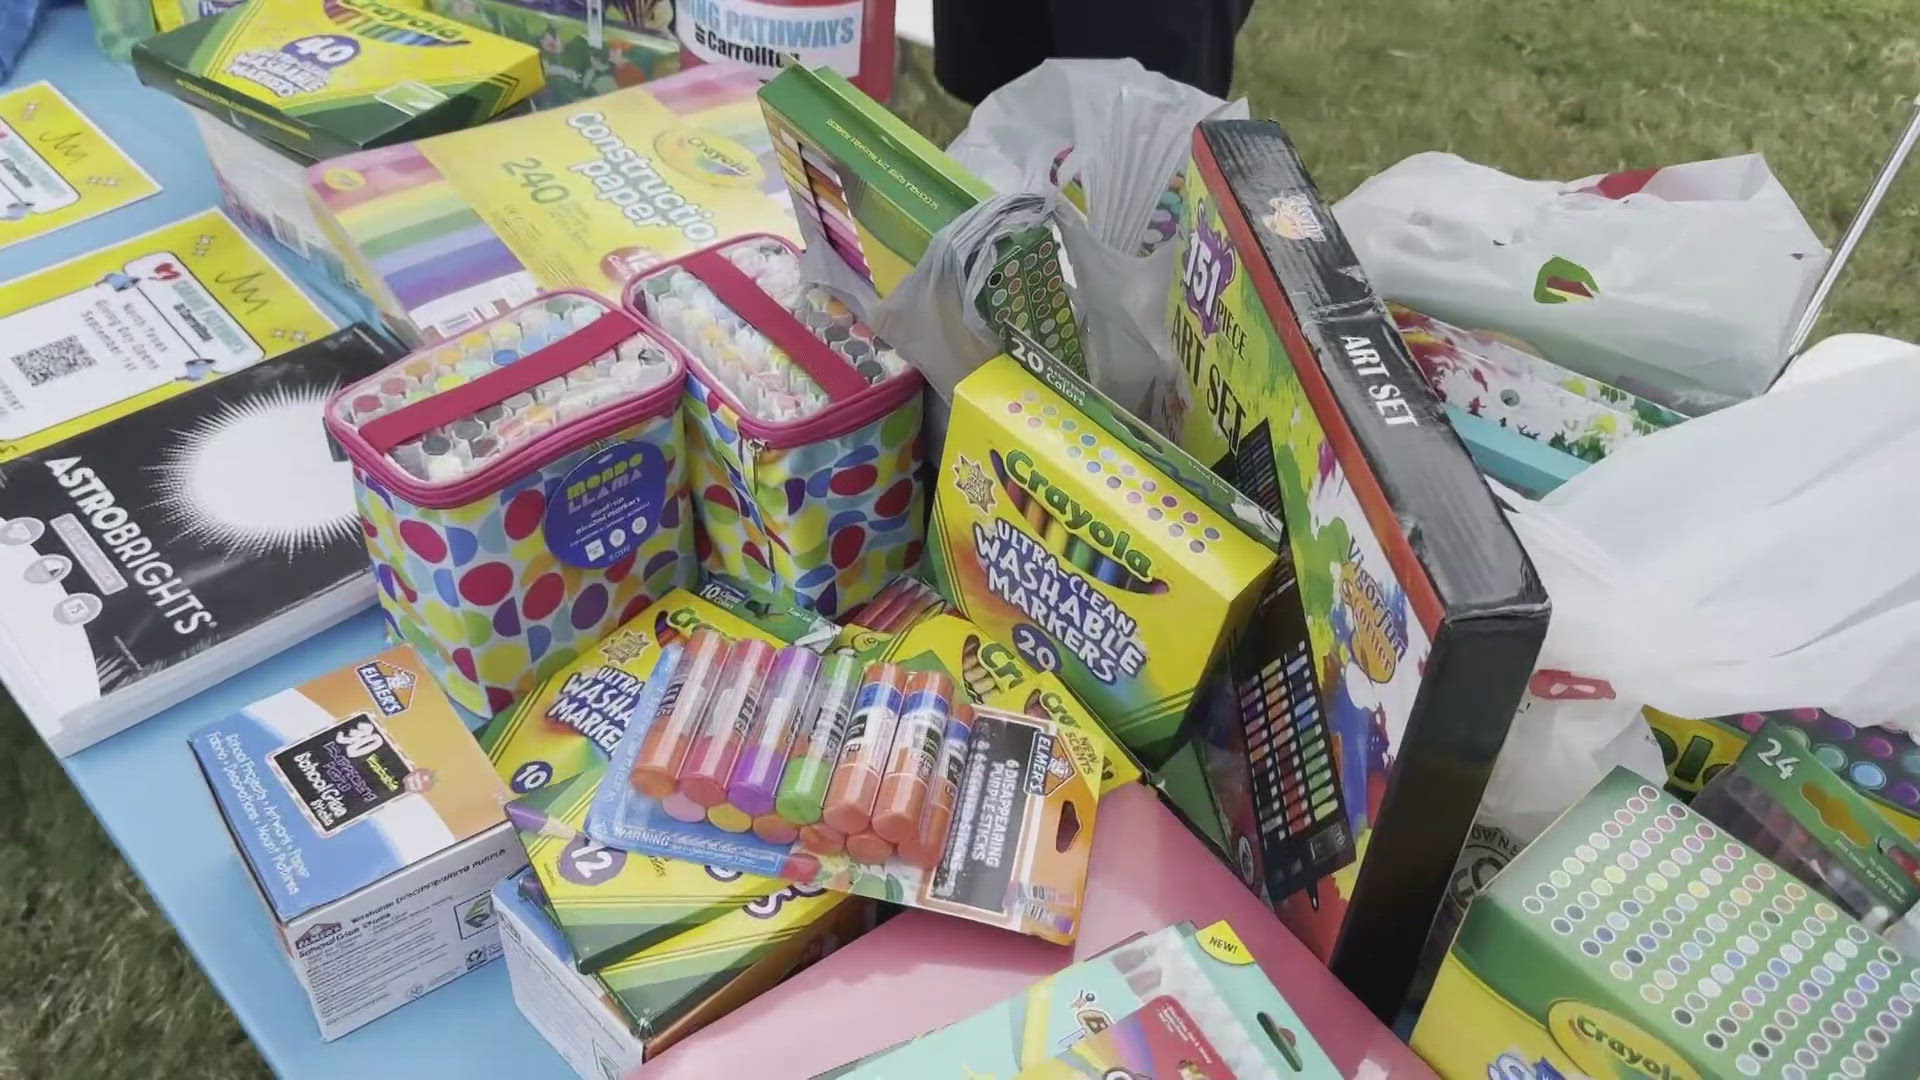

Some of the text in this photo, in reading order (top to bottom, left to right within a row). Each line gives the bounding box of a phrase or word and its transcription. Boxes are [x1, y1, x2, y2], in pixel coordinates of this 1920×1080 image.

[296, 37, 355, 63] 40
[708, 30, 799, 68] Carrollto
[726, 10, 854, 48] PATHWAYS
[502, 157, 570, 203] 240
[567, 112, 716, 241] Constructio
[568, 159, 670, 227] paper
[1184, 231, 1222, 318] 151
[1214, 298, 1248, 361] PIECE
[1011, 337, 1044, 374] 20
[1045, 373, 1085, 407] Colors
[1171, 304, 1247, 457] ART SET
[1340, 336, 1421, 428] ART SET
[1005, 450, 1153, 578] Crayola
[45, 456, 210, 634] ASTROBRIGHTS
[700, 583, 719, 599] 10
[975, 523, 1146, 676] WASHABLE
[996, 519, 1135, 635] ULTRA-CLEAN
[989, 564, 1117, 684] MARKERS
[1017, 631, 1056, 671] 20
[360, 666, 402, 714] ELMER'S
[561, 672, 637, 728] WASHA
[597, 666, 645, 696] ULTRA
[336, 722, 384, 758] 30
[546, 696, 625, 756] MARKE
[1079, 736, 1099, 764] NEW
[294, 751, 334, 793] School
[523, 766, 550, 788] 10
[1029, 736, 1052, 793] ELMER'S
[1065, 731, 1094, 775] SCENTS
[1757, 737, 1801, 781] 24
[614, 824, 672, 847] WARNING
[971, 761, 1005, 862] PURPLE STICKS
[986, 758, 1021, 868] 6 DISAPPEARING
[1208, 935, 1239, 955] NEW!
[1577, 1015, 1672, 1080] Crayol
